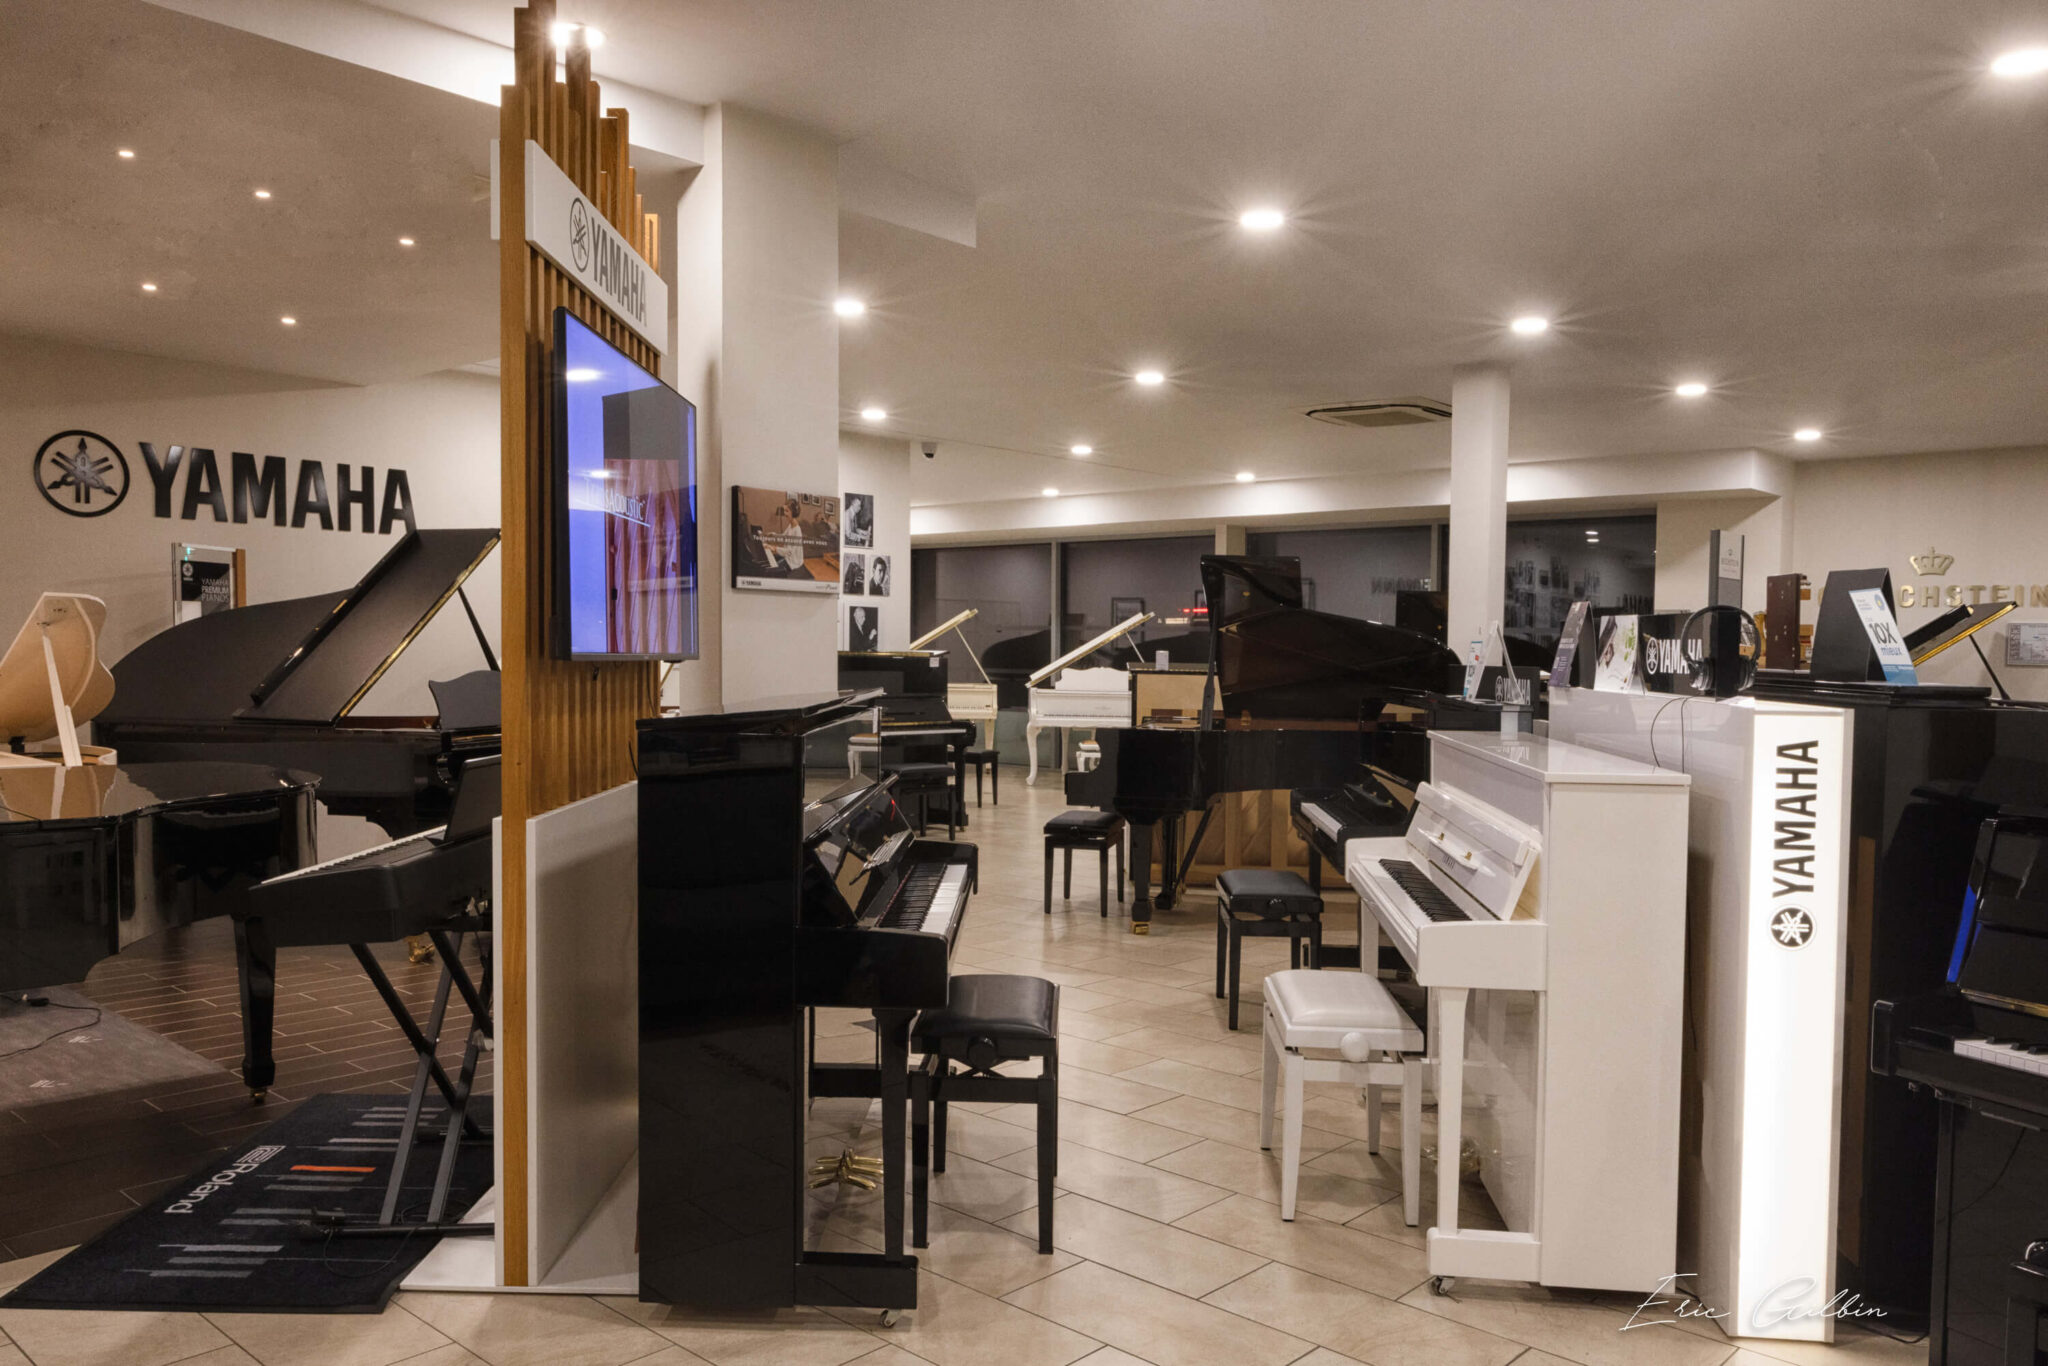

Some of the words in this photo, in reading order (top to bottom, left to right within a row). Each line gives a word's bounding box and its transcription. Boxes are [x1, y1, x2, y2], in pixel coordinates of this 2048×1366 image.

[591, 217, 648, 328] YAMAHA
[138, 441, 418, 535] YAMAHA
[1772, 740, 1819, 898] YAMAHA
[164, 1163, 260, 1214] Roland
